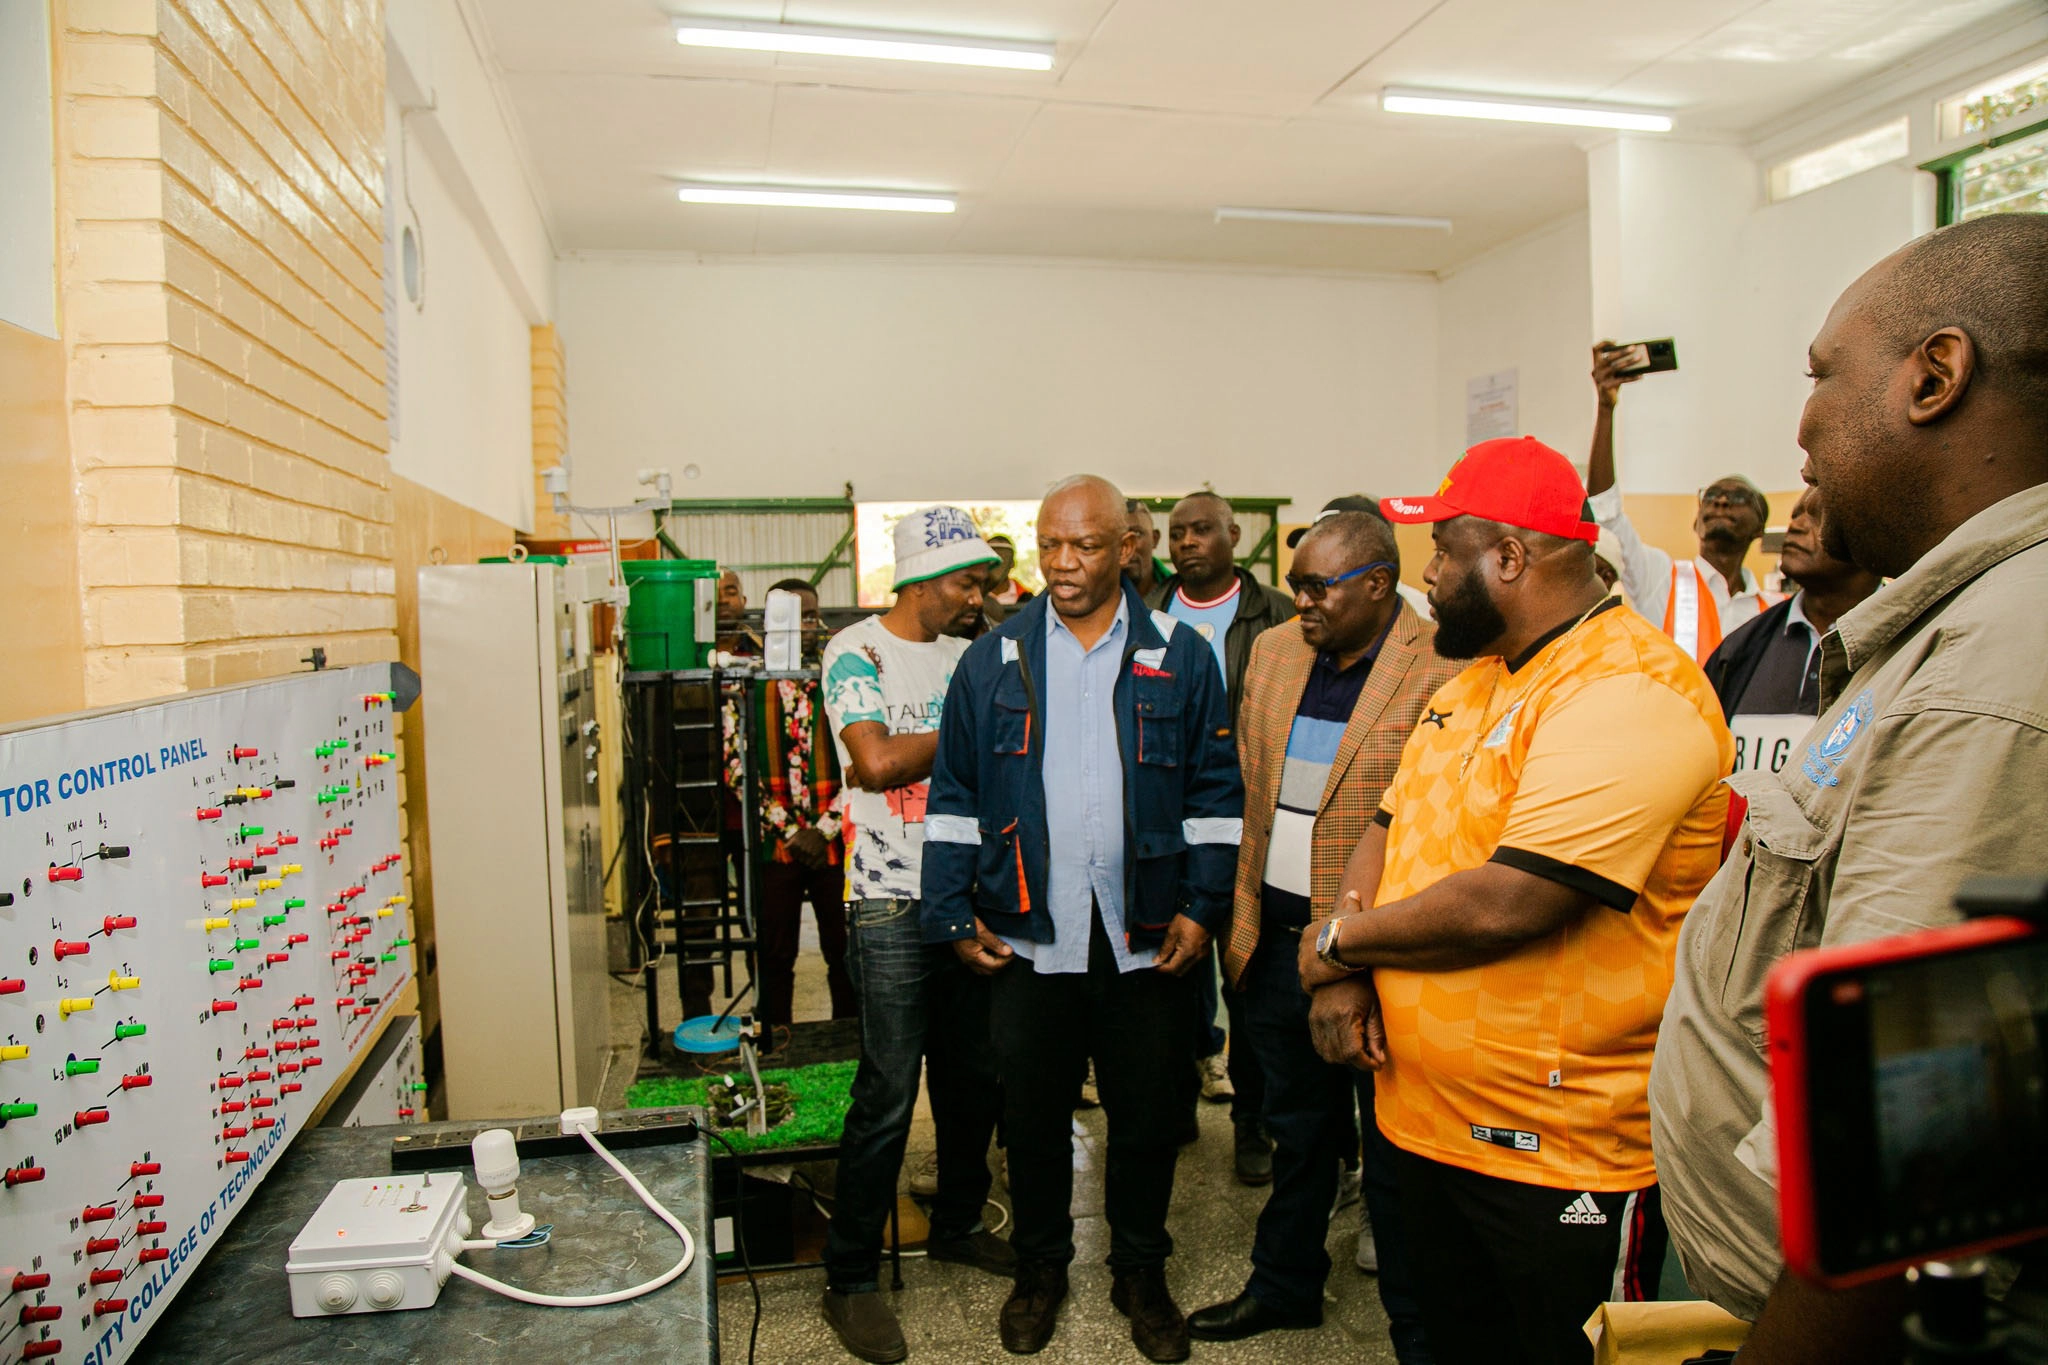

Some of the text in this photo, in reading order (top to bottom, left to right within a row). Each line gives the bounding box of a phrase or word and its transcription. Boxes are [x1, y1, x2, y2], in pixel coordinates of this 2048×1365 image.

[0, 737, 208, 817] TOR CONTROL PANEL
[53, 1068, 65, 1081] L3
[70, 1217, 79, 1234] NO
[130, 1226, 197, 1323] COLLEGE
[200, 1201, 216, 1235] OF
[220, 1113, 287, 1211] TECHNOLOGY
[1560, 1211, 1607, 1225] adidas
[32, 1255, 42, 1272] NO
[36, 1289, 46, 1306] NC
